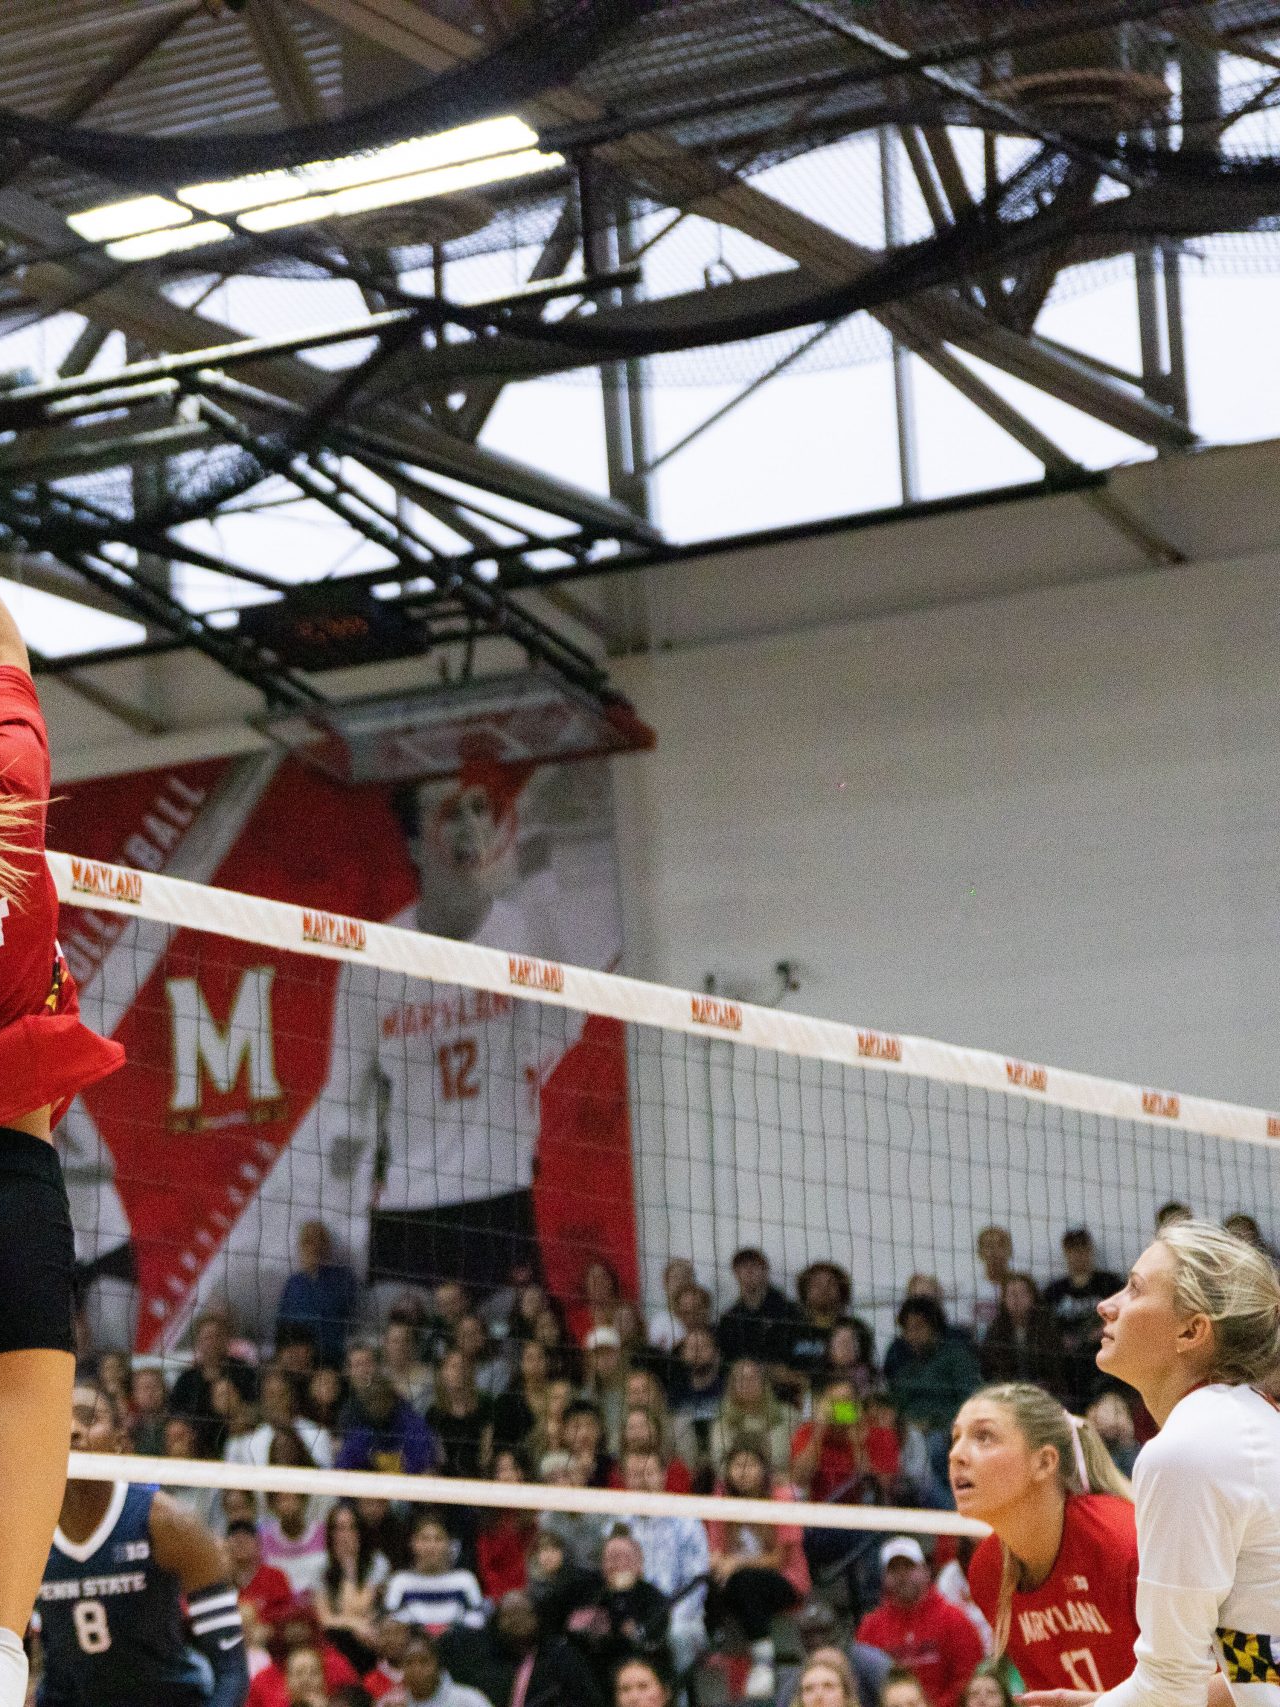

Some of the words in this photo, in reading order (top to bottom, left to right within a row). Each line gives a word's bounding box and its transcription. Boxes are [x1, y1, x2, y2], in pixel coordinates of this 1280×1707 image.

[71, 857, 143, 900] MARYLAND
[303, 910, 366, 948] MARYLAND
[165, 966, 282, 1111] M
[438, 1039, 480, 1103] 12
[82, 1571, 147, 1597] STATE
[73, 1600, 112, 1655] 8
[1060, 1648, 1105, 1693] 17
